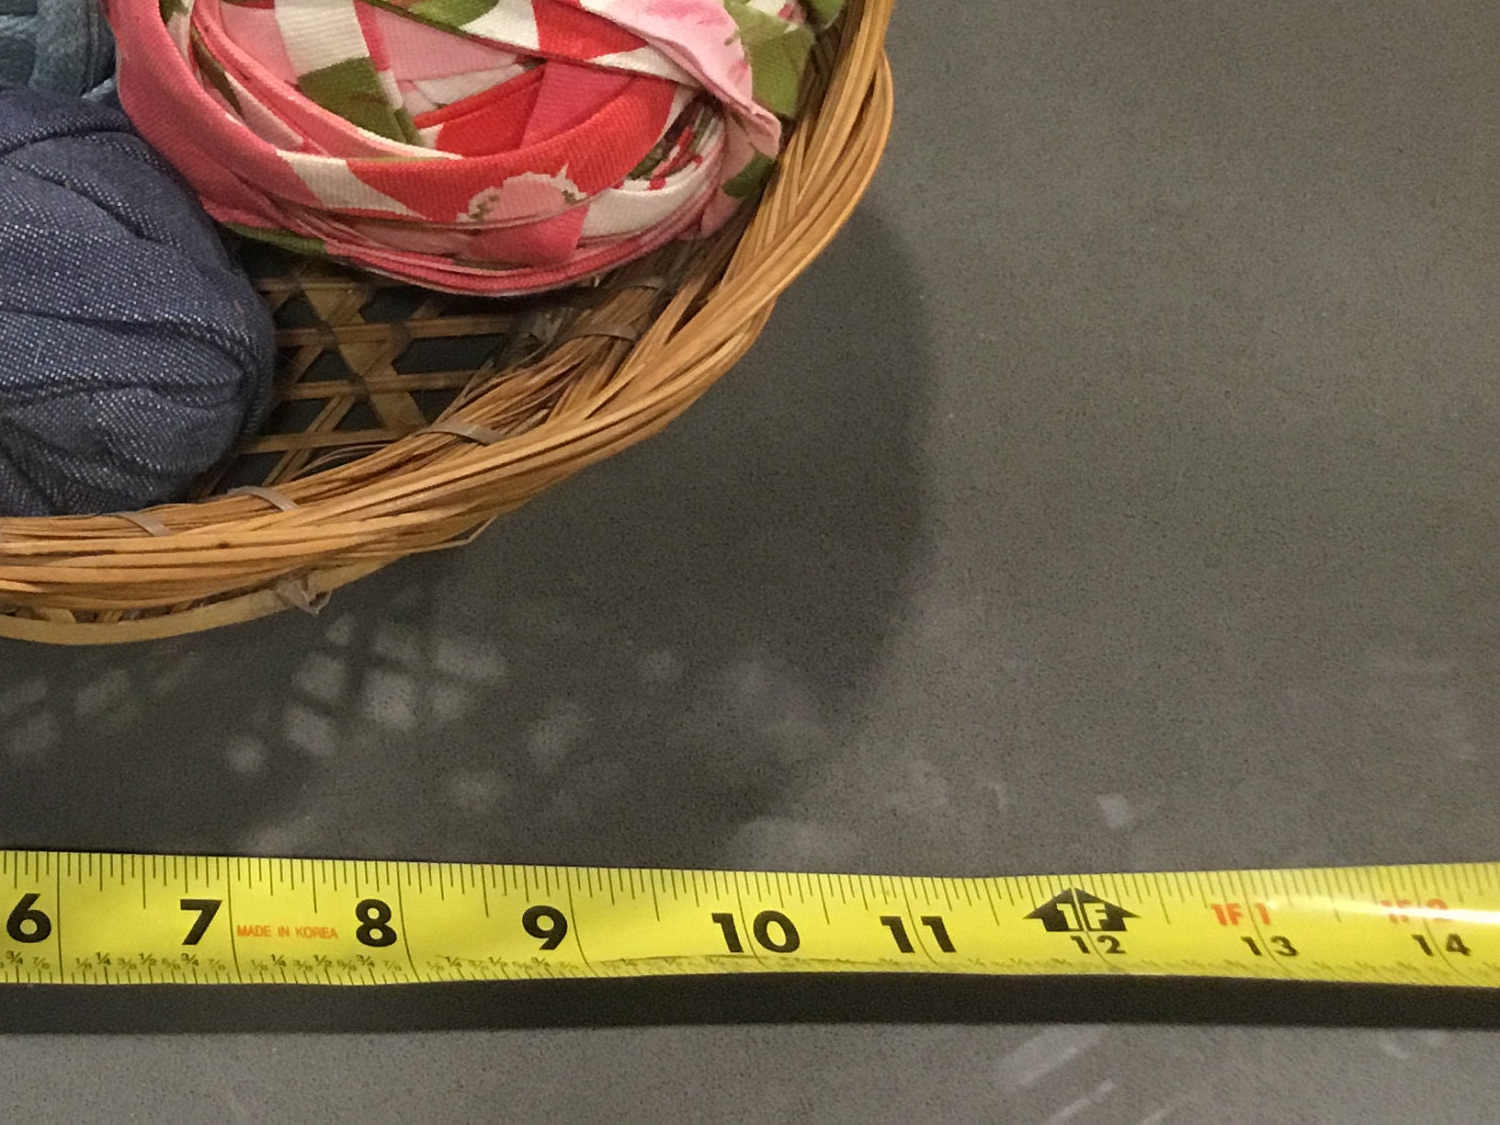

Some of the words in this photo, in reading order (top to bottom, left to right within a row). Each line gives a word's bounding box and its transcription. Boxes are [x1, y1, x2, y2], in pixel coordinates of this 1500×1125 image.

[6, 893, 52, 943] 6
[180, 899, 222, 945] 7
[355, 899, 398, 948] 8
[521, 905, 568, 950] 9
[711, 910, 801, 954] 10
[880, 915, 957, 954] 11
[1055, 902, 1109, 930] 1F
[237, 925, 271, 937] MADE
[277, 926, 290, 937] IN
[295, 926, 339, 939] KOREA
[1070, 935, 1127, 954] 12
[1240, 935, 1299, 957] 13
[1411, 933, 1471, 957] 14
